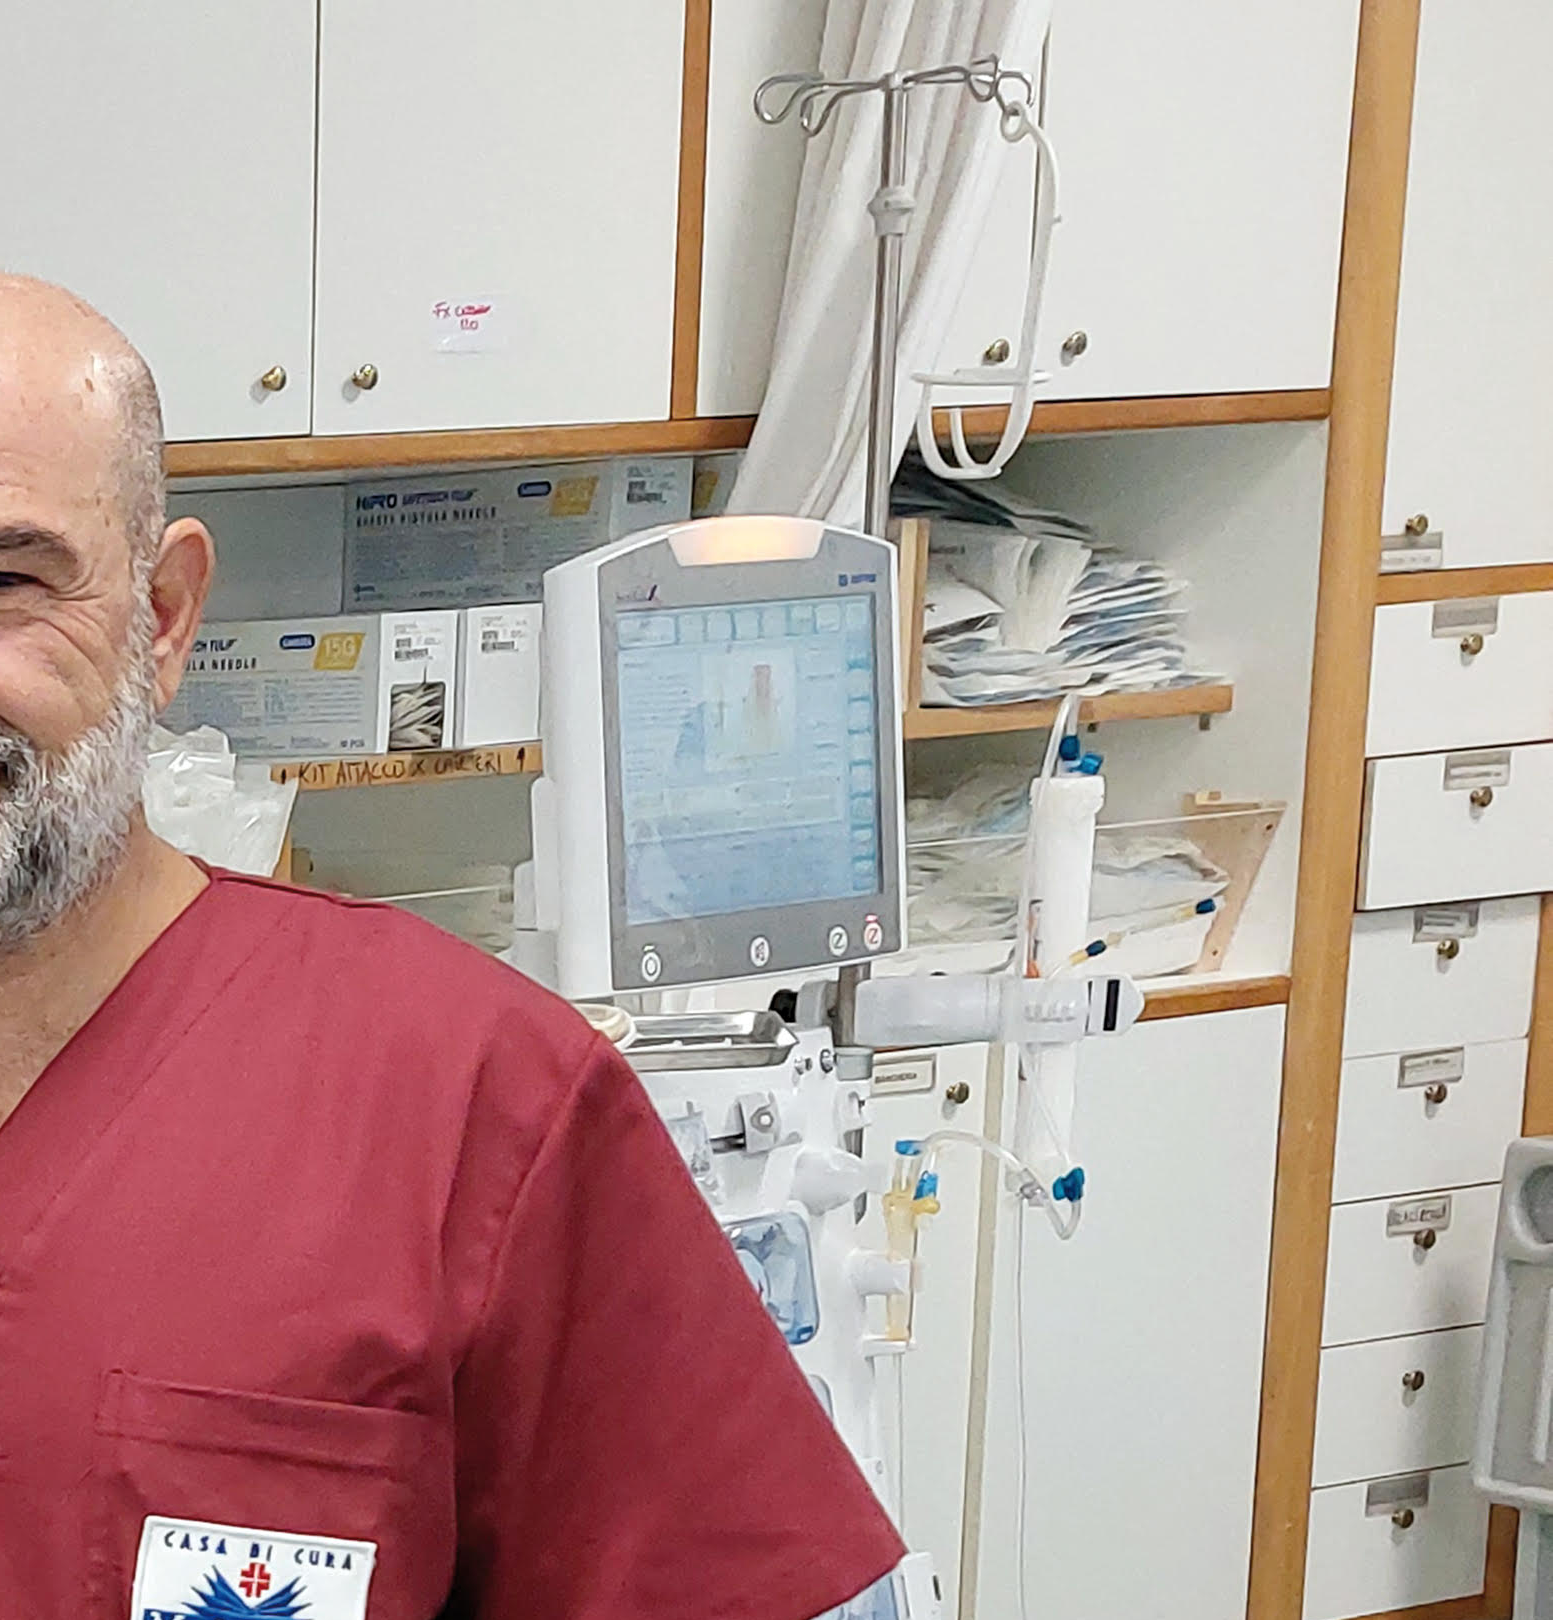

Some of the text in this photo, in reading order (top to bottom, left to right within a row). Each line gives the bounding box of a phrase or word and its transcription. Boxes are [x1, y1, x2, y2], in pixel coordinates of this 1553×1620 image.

[212, 657, 258, 672] NEEDLE
[298, 762, 326, 785] KIT
[164, 1530, 353, 1571] CASA DI CURA
